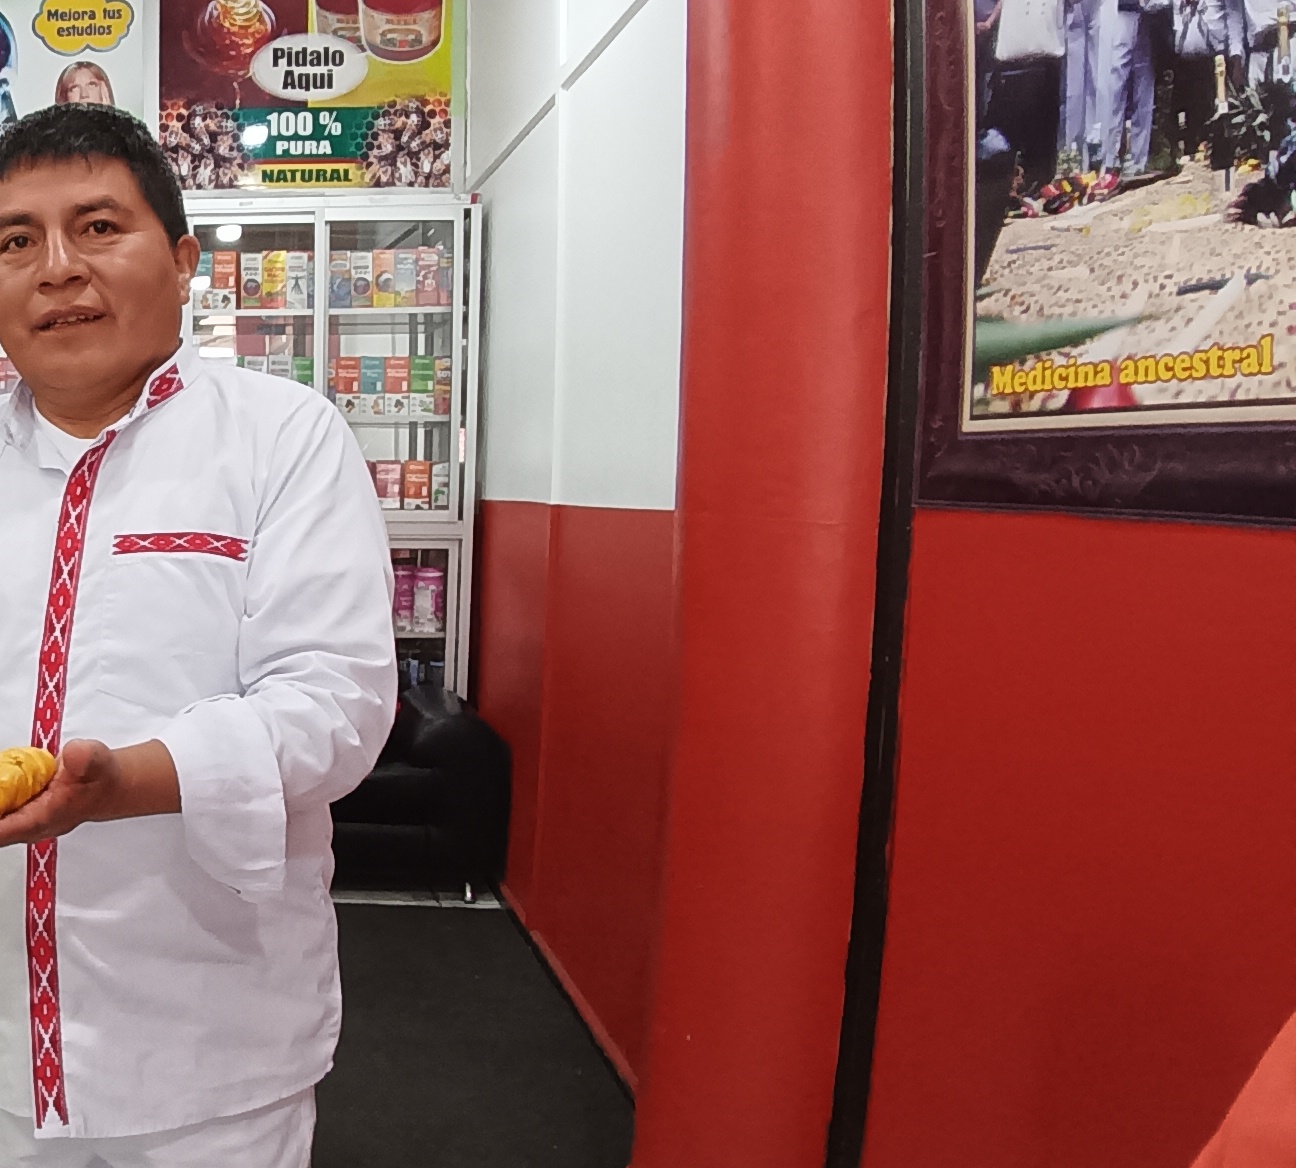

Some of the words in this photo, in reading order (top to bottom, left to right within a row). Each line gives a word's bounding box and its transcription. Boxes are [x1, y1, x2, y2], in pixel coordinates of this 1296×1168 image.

[47, 8, 96, 22] Mejora
[103, 8, 122, 20] tus
[57, 23, 112, 37] estudios
[272, 46, 345, 68] Pidalo
[282, 69, 334, 92] Aqui
[266, 111, 314, 136] 100
[319, 111, 342, 136] %
[275, 140, 332, 155] PURA
[261, 169, 353, 183] NATURAL
[991, 356, 1111, 395] Medicina
[1119, 334, 1275, 385] ancestral
